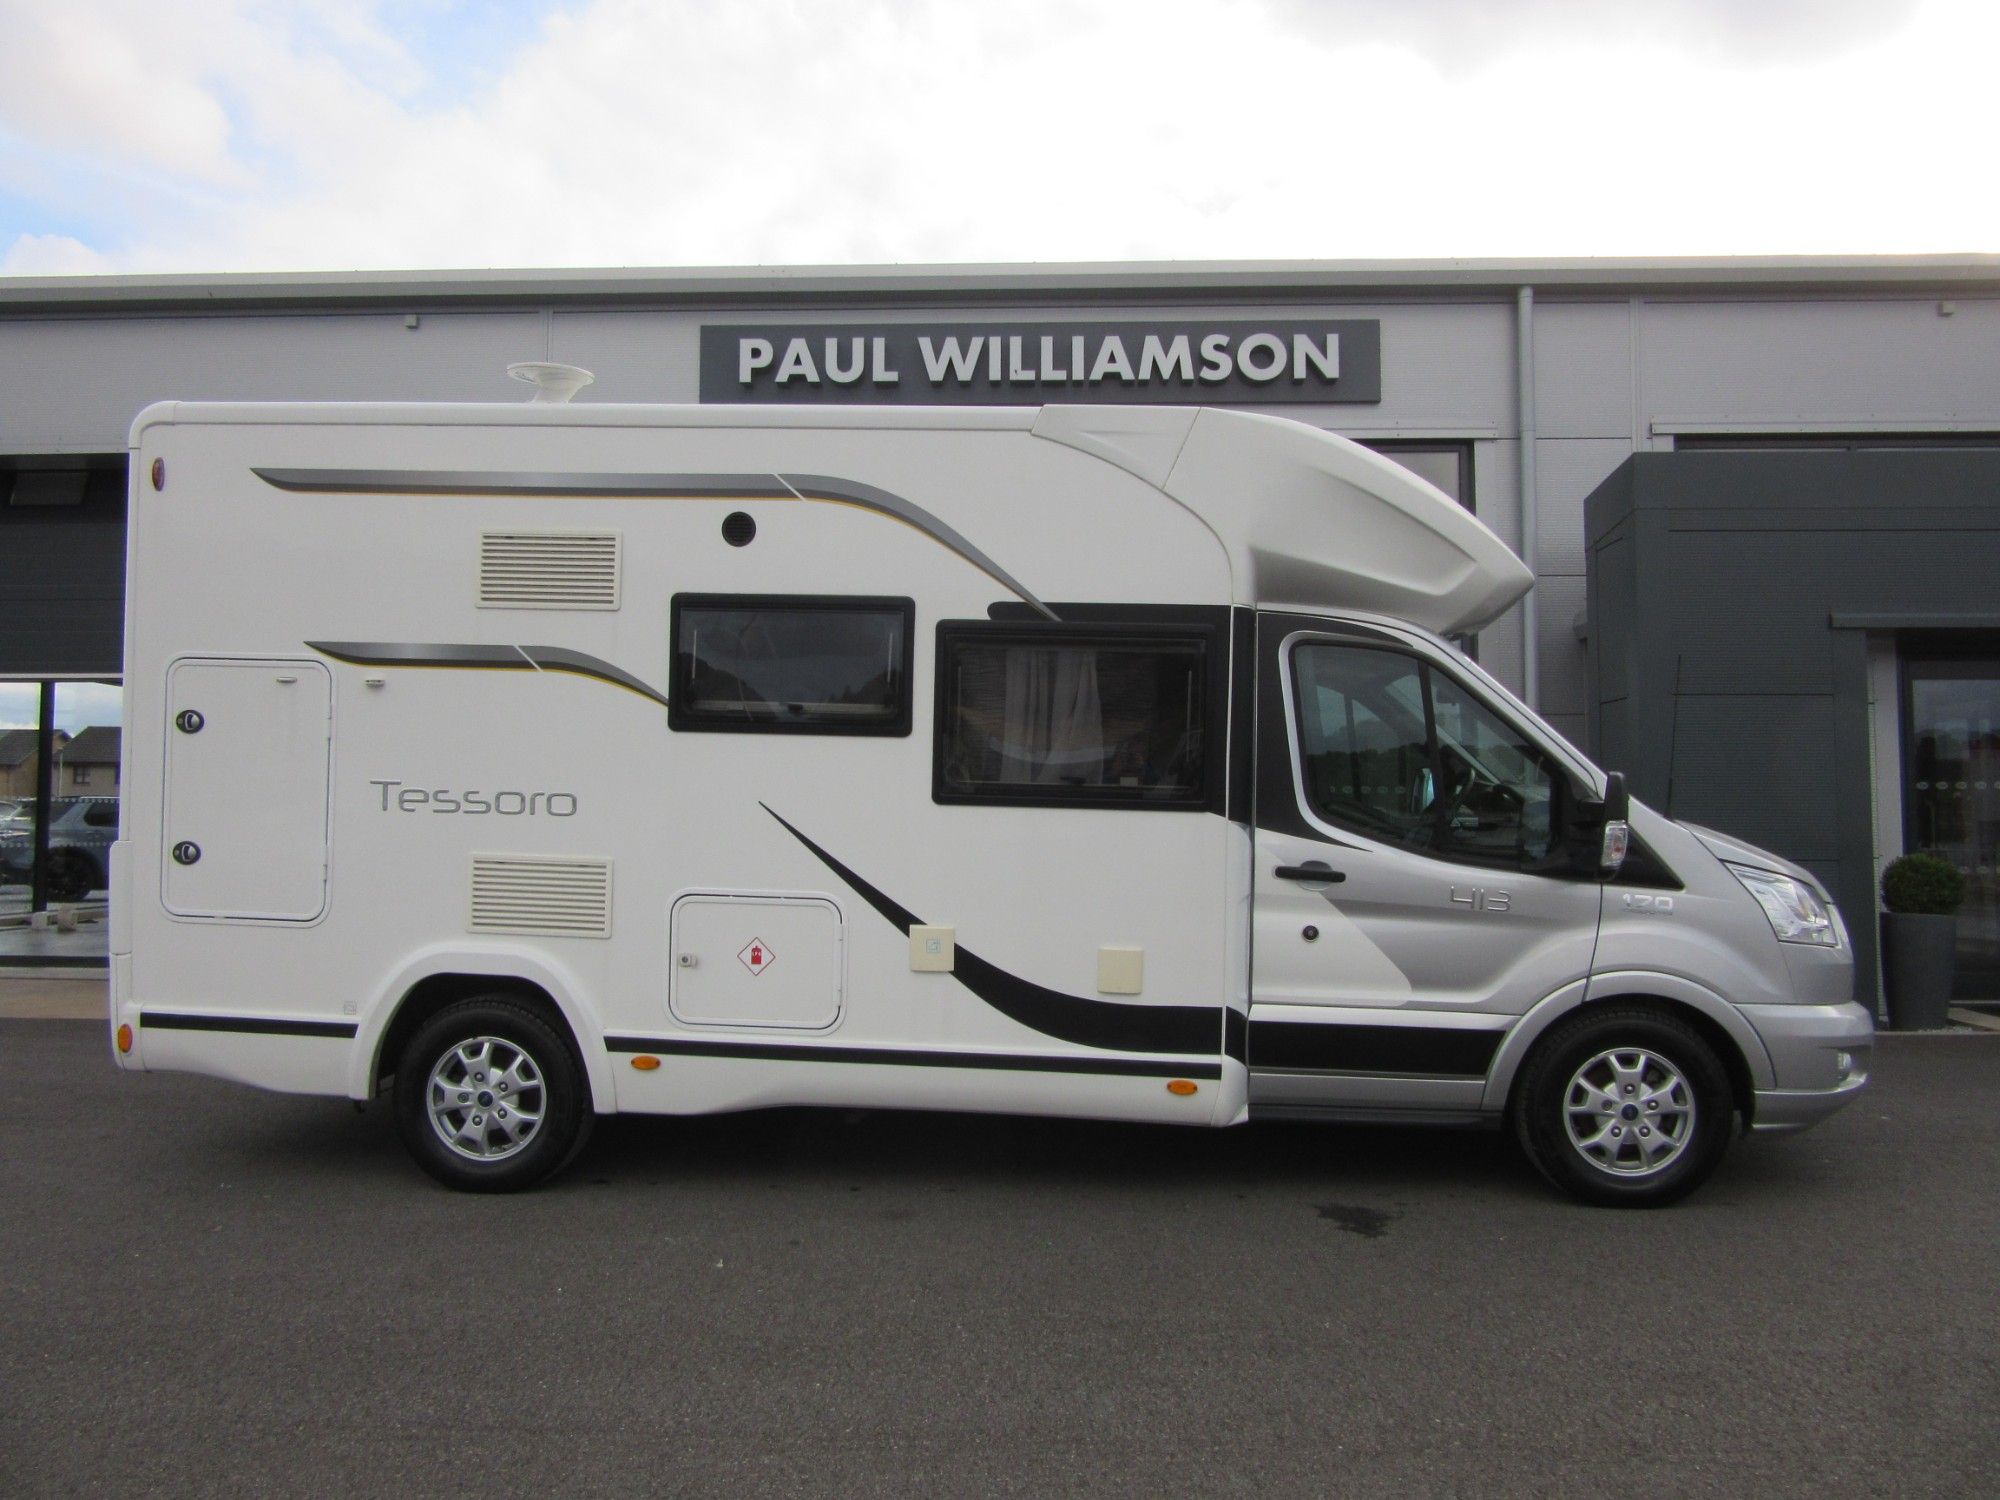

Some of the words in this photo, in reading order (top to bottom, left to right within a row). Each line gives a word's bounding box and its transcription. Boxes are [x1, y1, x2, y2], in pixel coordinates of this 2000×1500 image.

[738, 336, 899, 384] PAUL
[918, 332, 1341, 383] WILLIAMSON
[369, 780, 578, 817] Tessoro
